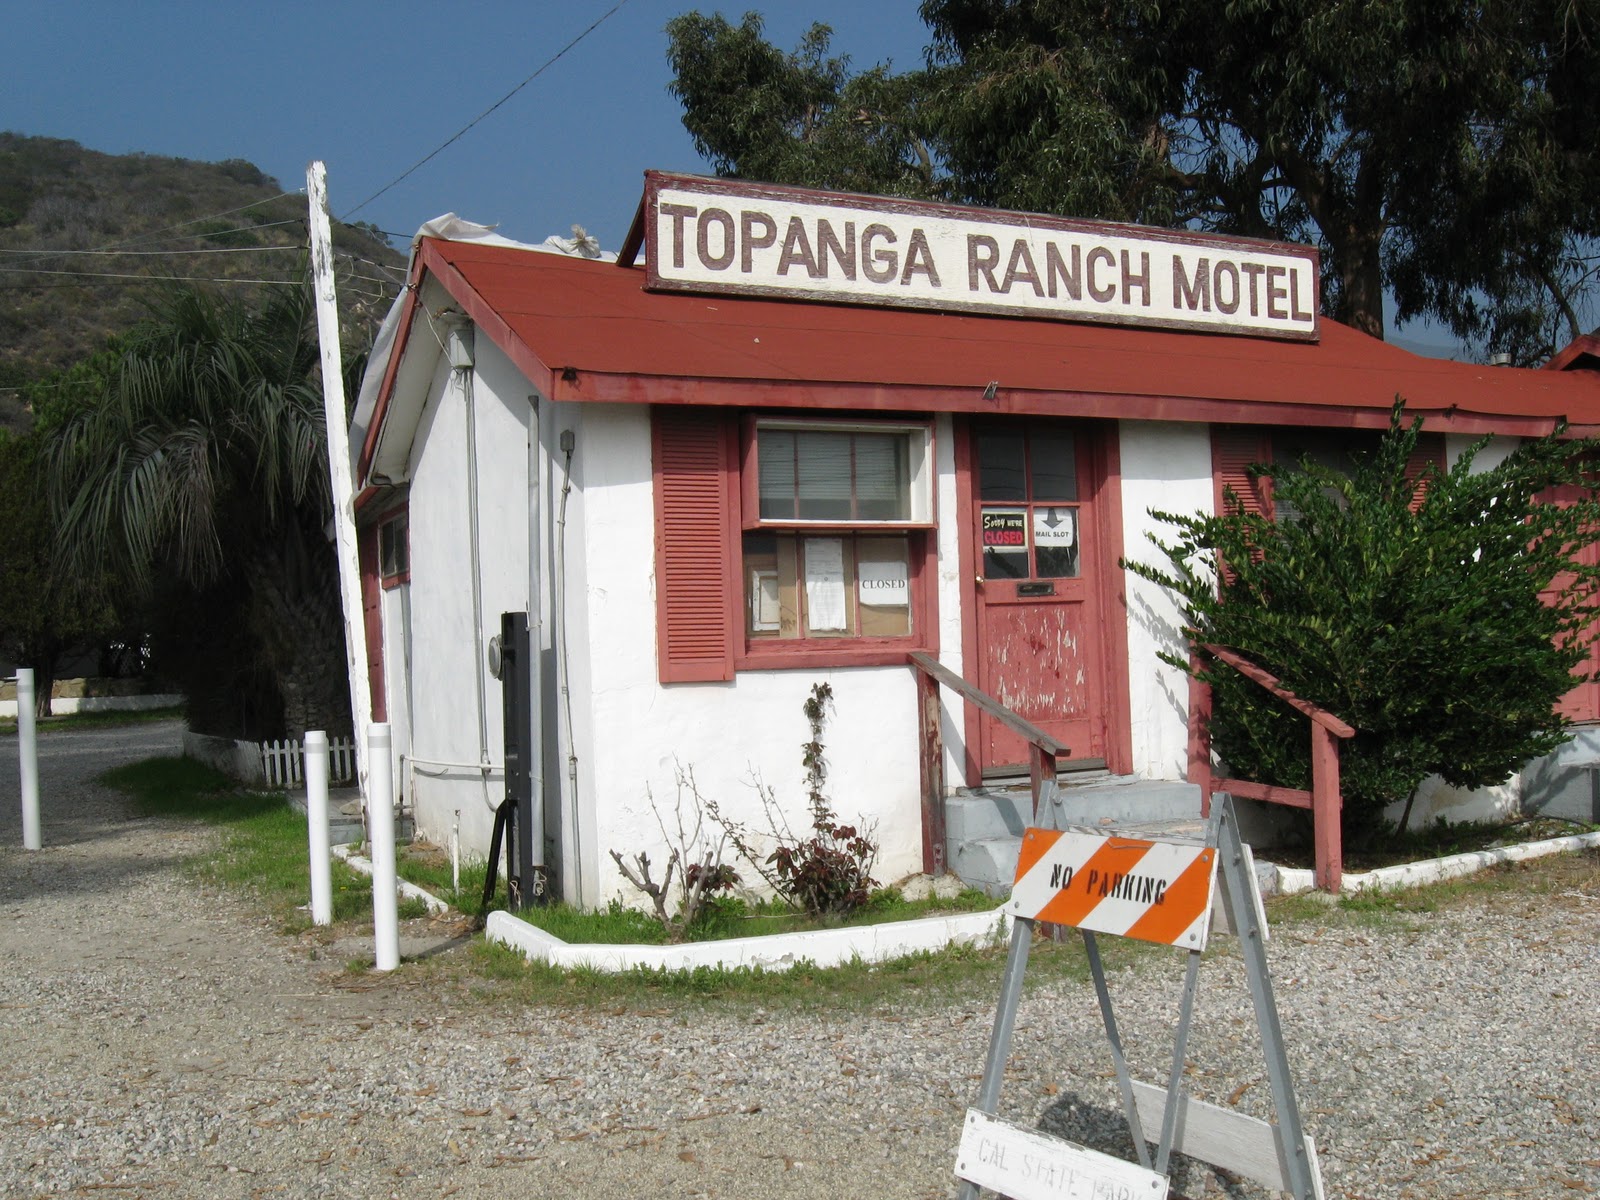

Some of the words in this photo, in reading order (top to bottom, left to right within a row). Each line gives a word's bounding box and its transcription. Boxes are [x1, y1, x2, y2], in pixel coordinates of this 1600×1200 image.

[660, 203, 942, 288] TOPANGA
[967, 233, 1151, 307] RANCH
[1172, 254, 1313, 323] MOTEL
[985, 531, 1022, 544] CLOSED
[862, 579, 905, 589] CLOSED
[1050, 863, 1073, 890] NO
[1087, 869, 1167, 905] PARKING
[978, 1137, 1009, 1171] CAL
